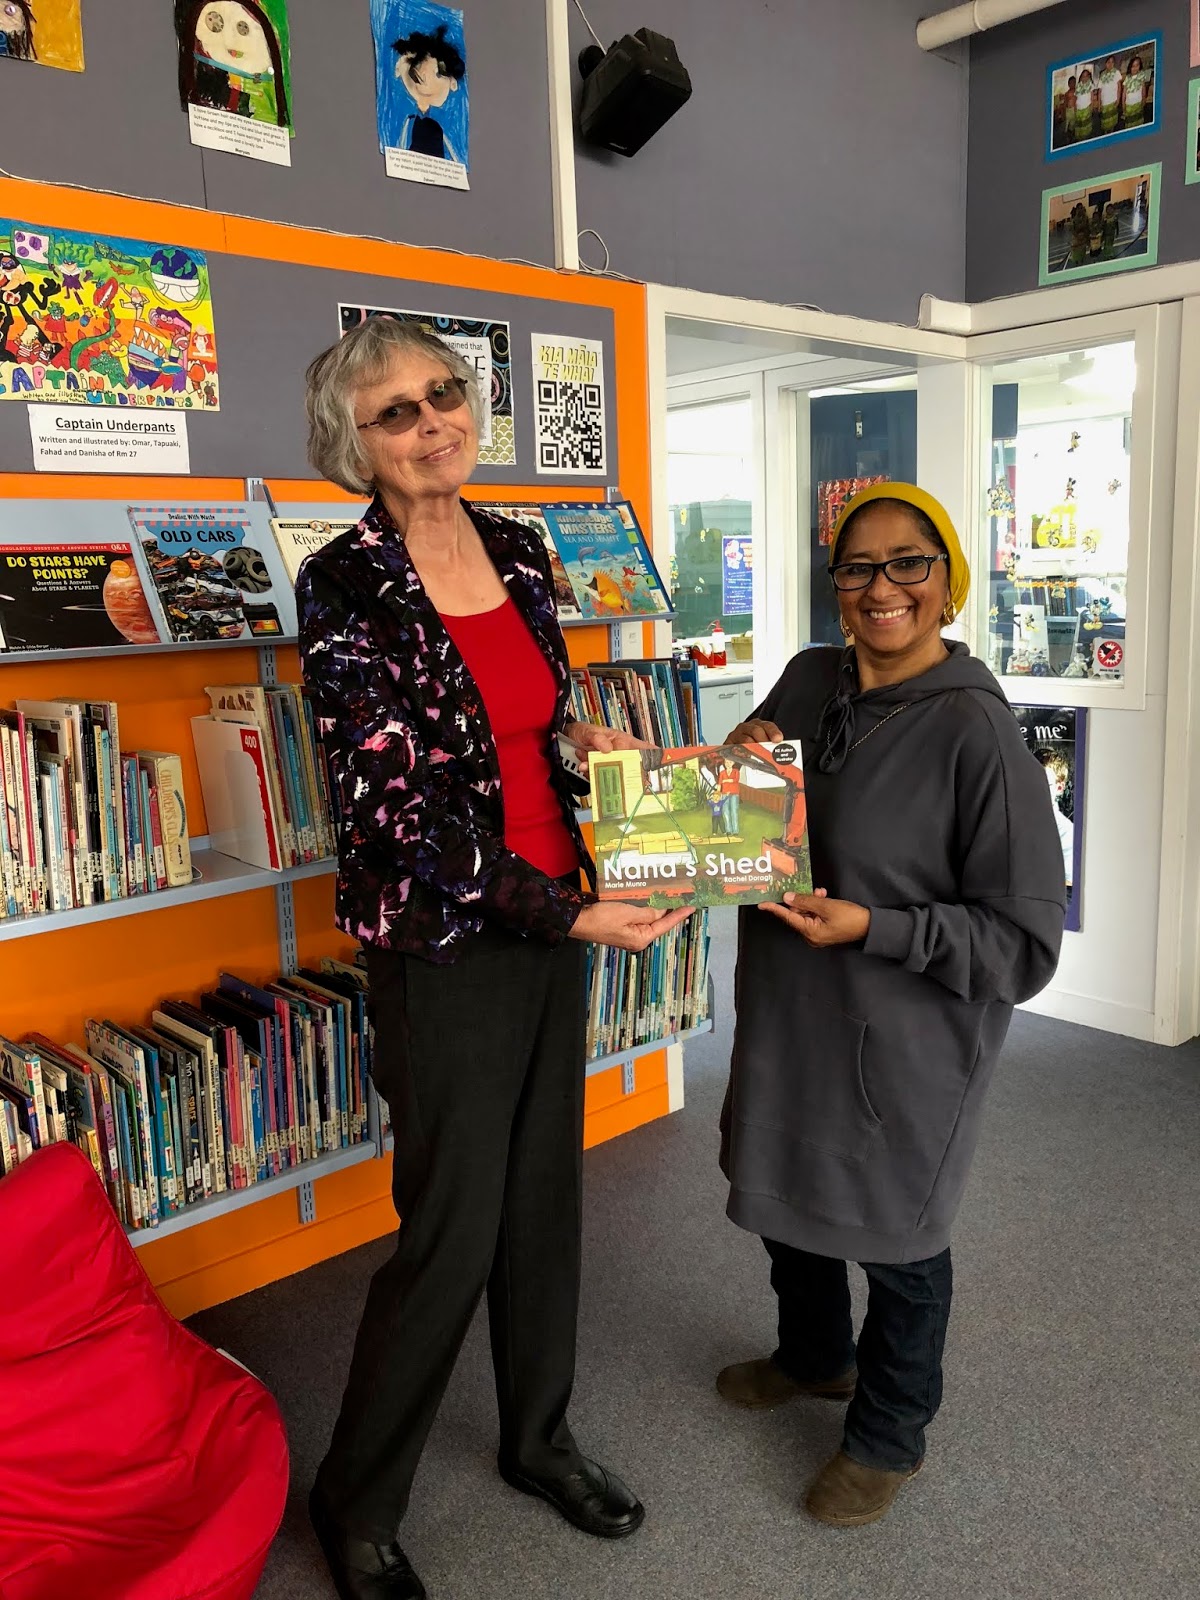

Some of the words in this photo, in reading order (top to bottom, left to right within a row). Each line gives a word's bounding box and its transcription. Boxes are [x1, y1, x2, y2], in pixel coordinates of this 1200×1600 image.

[540, 345, 564, 363] KIA
[543, 363, 560, 379] TE
[562, 364, 595, 382] WHAI
[56, 417, 103, 430] Captain
[107, 420, 176, 433] Underpants
[154, 440, 181, 448] Tapuaki,
[160, 530, 192, 542] OLD
[197, 530, 236, 542] CARS
[558, 523, 617, 535] MASTERS
[292, 534, 330, 545] Rivers
[6, 556, 27, 567] DO
[29, 555, 72, 567] STARS
[73, 555, 107, 566] HAVE
[32, 568, 89, 580] POINTS?
[160, 768, 177, 821] CHILDREN'S
[705, 850, 772, 876] Shed
[188, 1096, 196, 1121] SPACE
